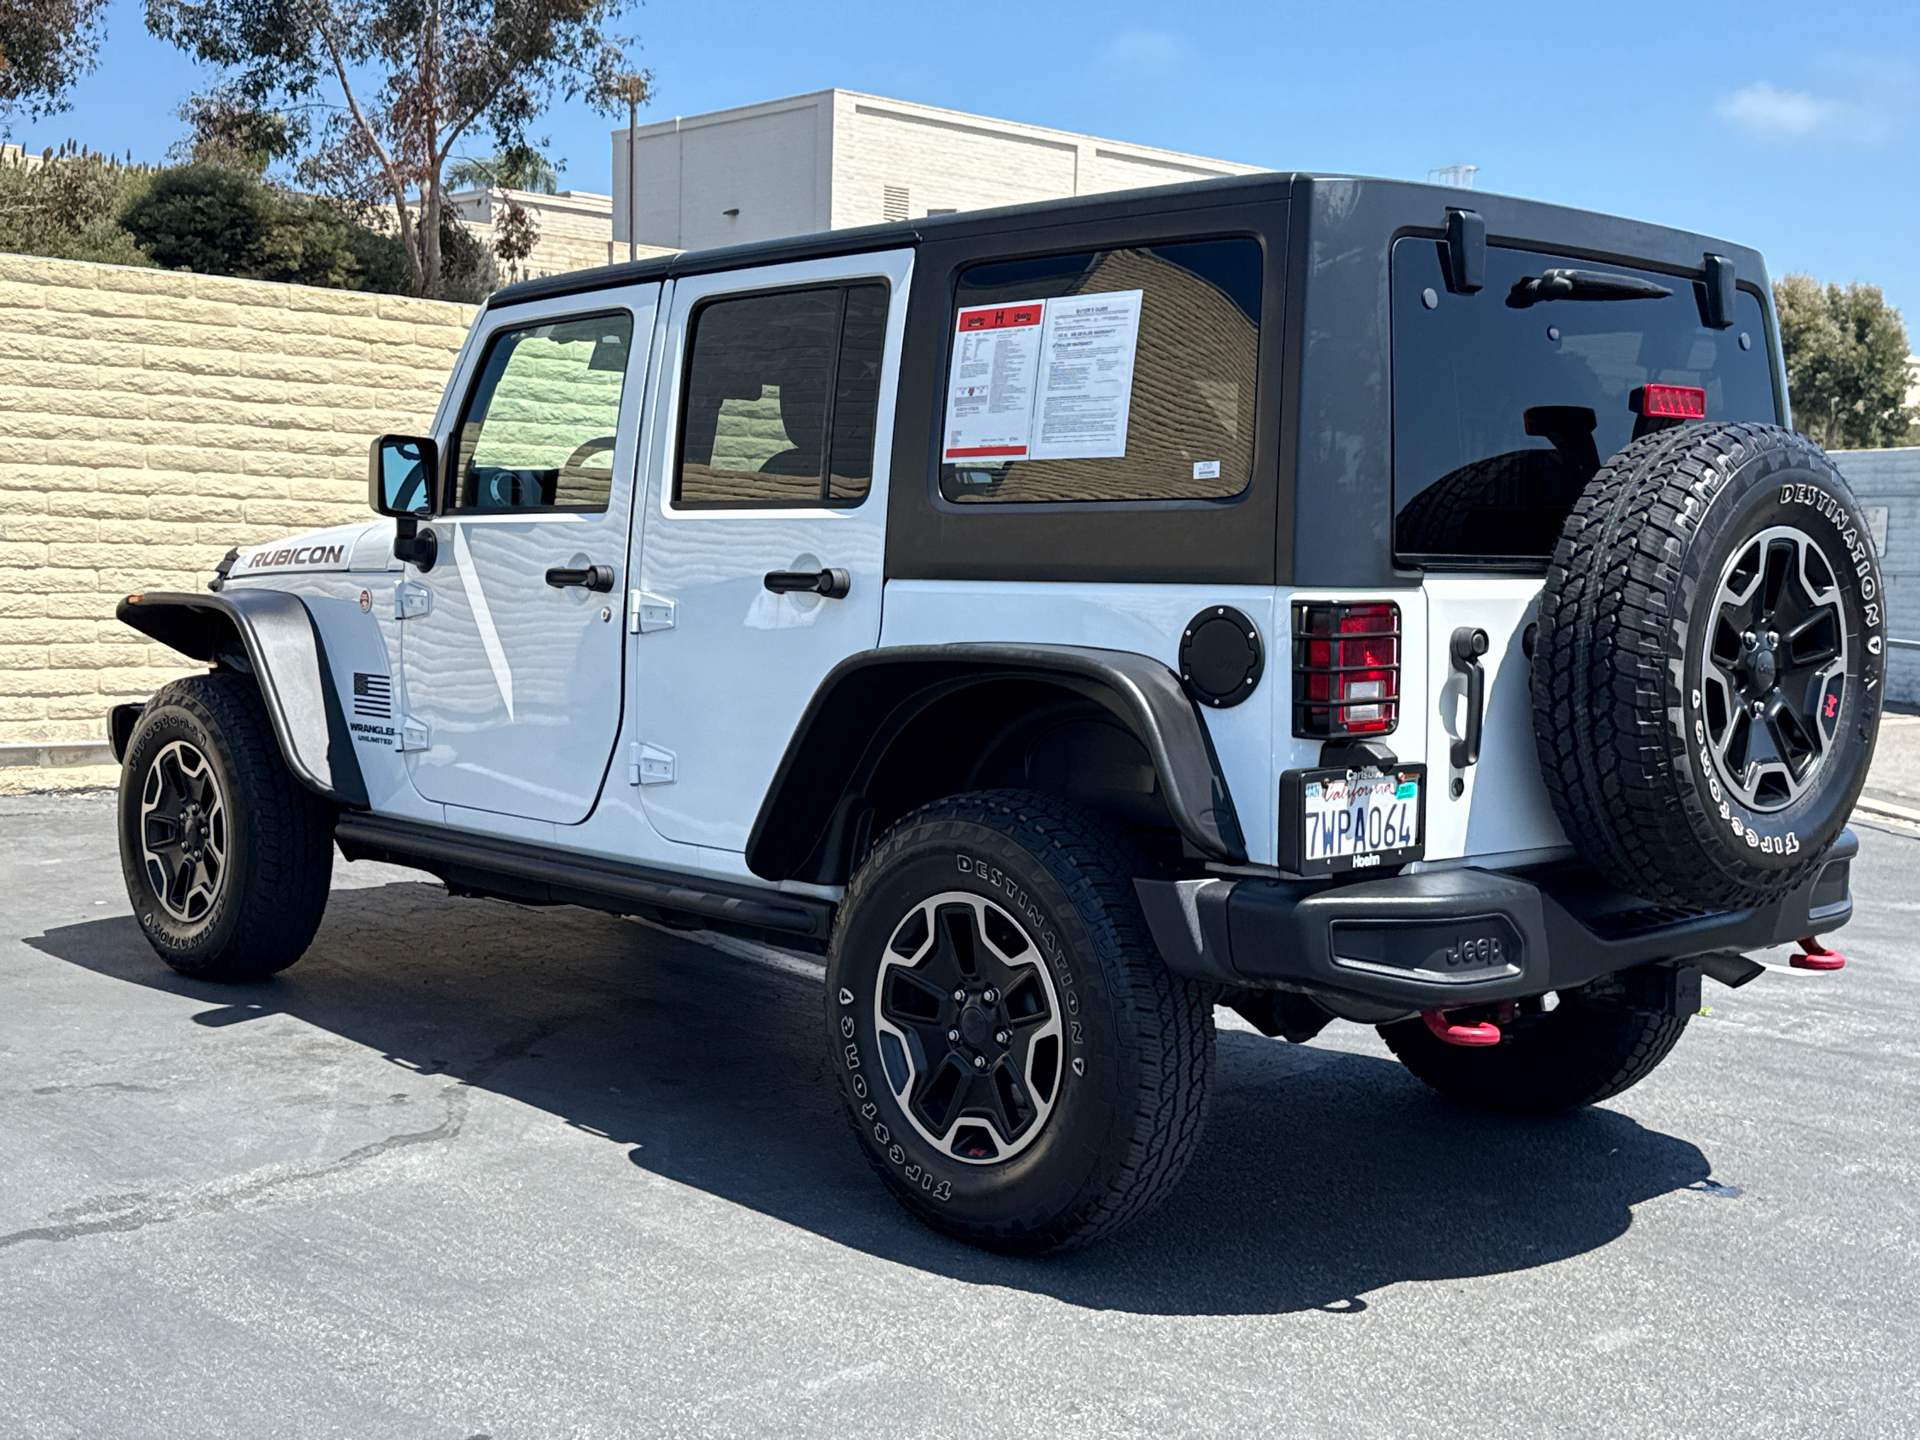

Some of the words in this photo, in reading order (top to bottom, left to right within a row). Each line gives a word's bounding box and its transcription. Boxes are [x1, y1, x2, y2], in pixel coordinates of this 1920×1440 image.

[248, 545, 345, 568] RUBICON
[1778, 482, 1880, 629] DESTINATION
[350, 722, 395, 736] WRANGLER
[358, 735, 393, 745] UNLIMITED
[1323, 780, 1394, 806] California
[1305, 803, 1411, 857] 7WPA064
[1352, 854, 1381, 868] Hoehn
[956, 853, 1085, 1045] DESTINATION
[1446, 936, 1501, 966] Jeep
[840, 1015, 953, 1201] Firestone
